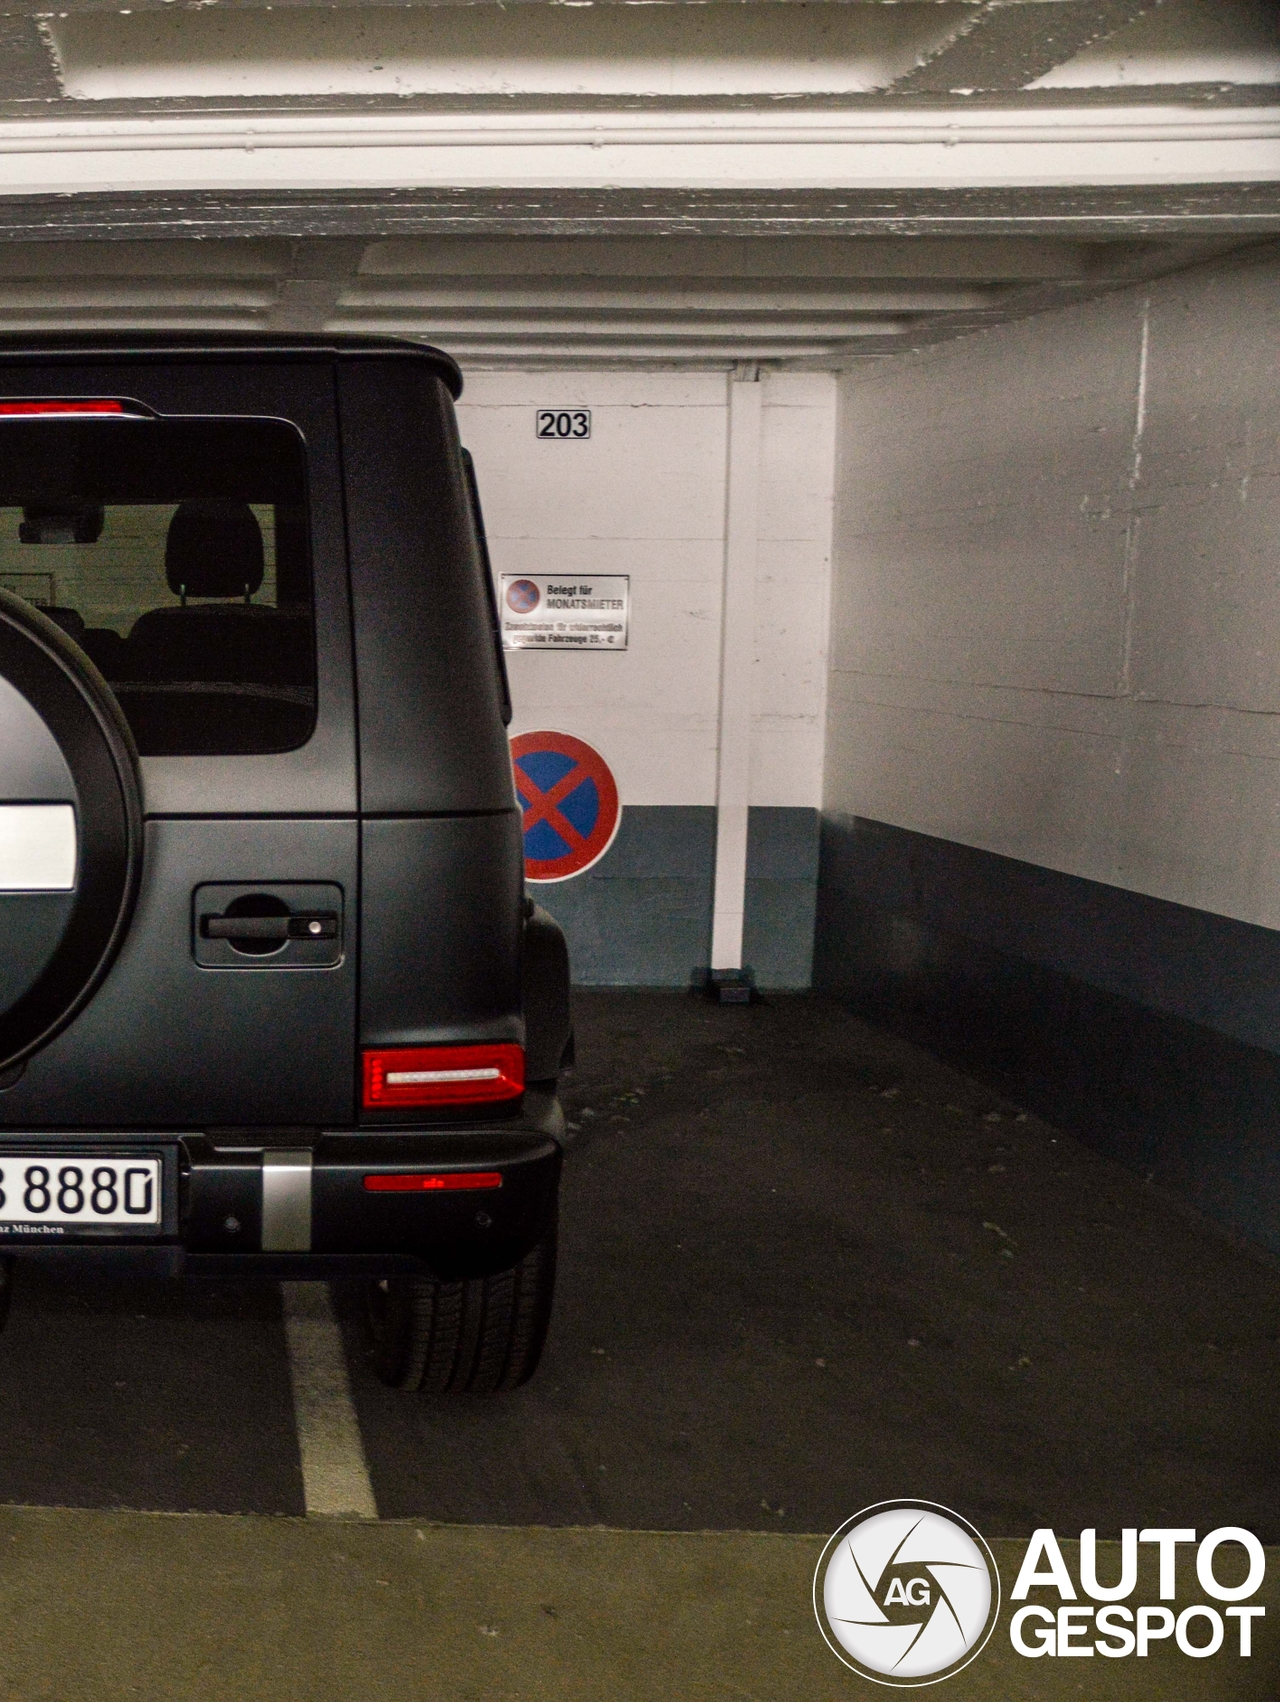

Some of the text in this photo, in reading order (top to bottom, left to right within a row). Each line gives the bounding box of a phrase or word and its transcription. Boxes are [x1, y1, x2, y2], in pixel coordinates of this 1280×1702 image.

[539, 412, 588, 437] 203
[546, 584, 593, 597] Belegt für
[546, 598, 624, 610] MONATSMIETER
[548, 634, 587, 644] Fahrzeuge
[23, 1165, 153, 1215] 8880
[12, 1223, 65, 1235] München
